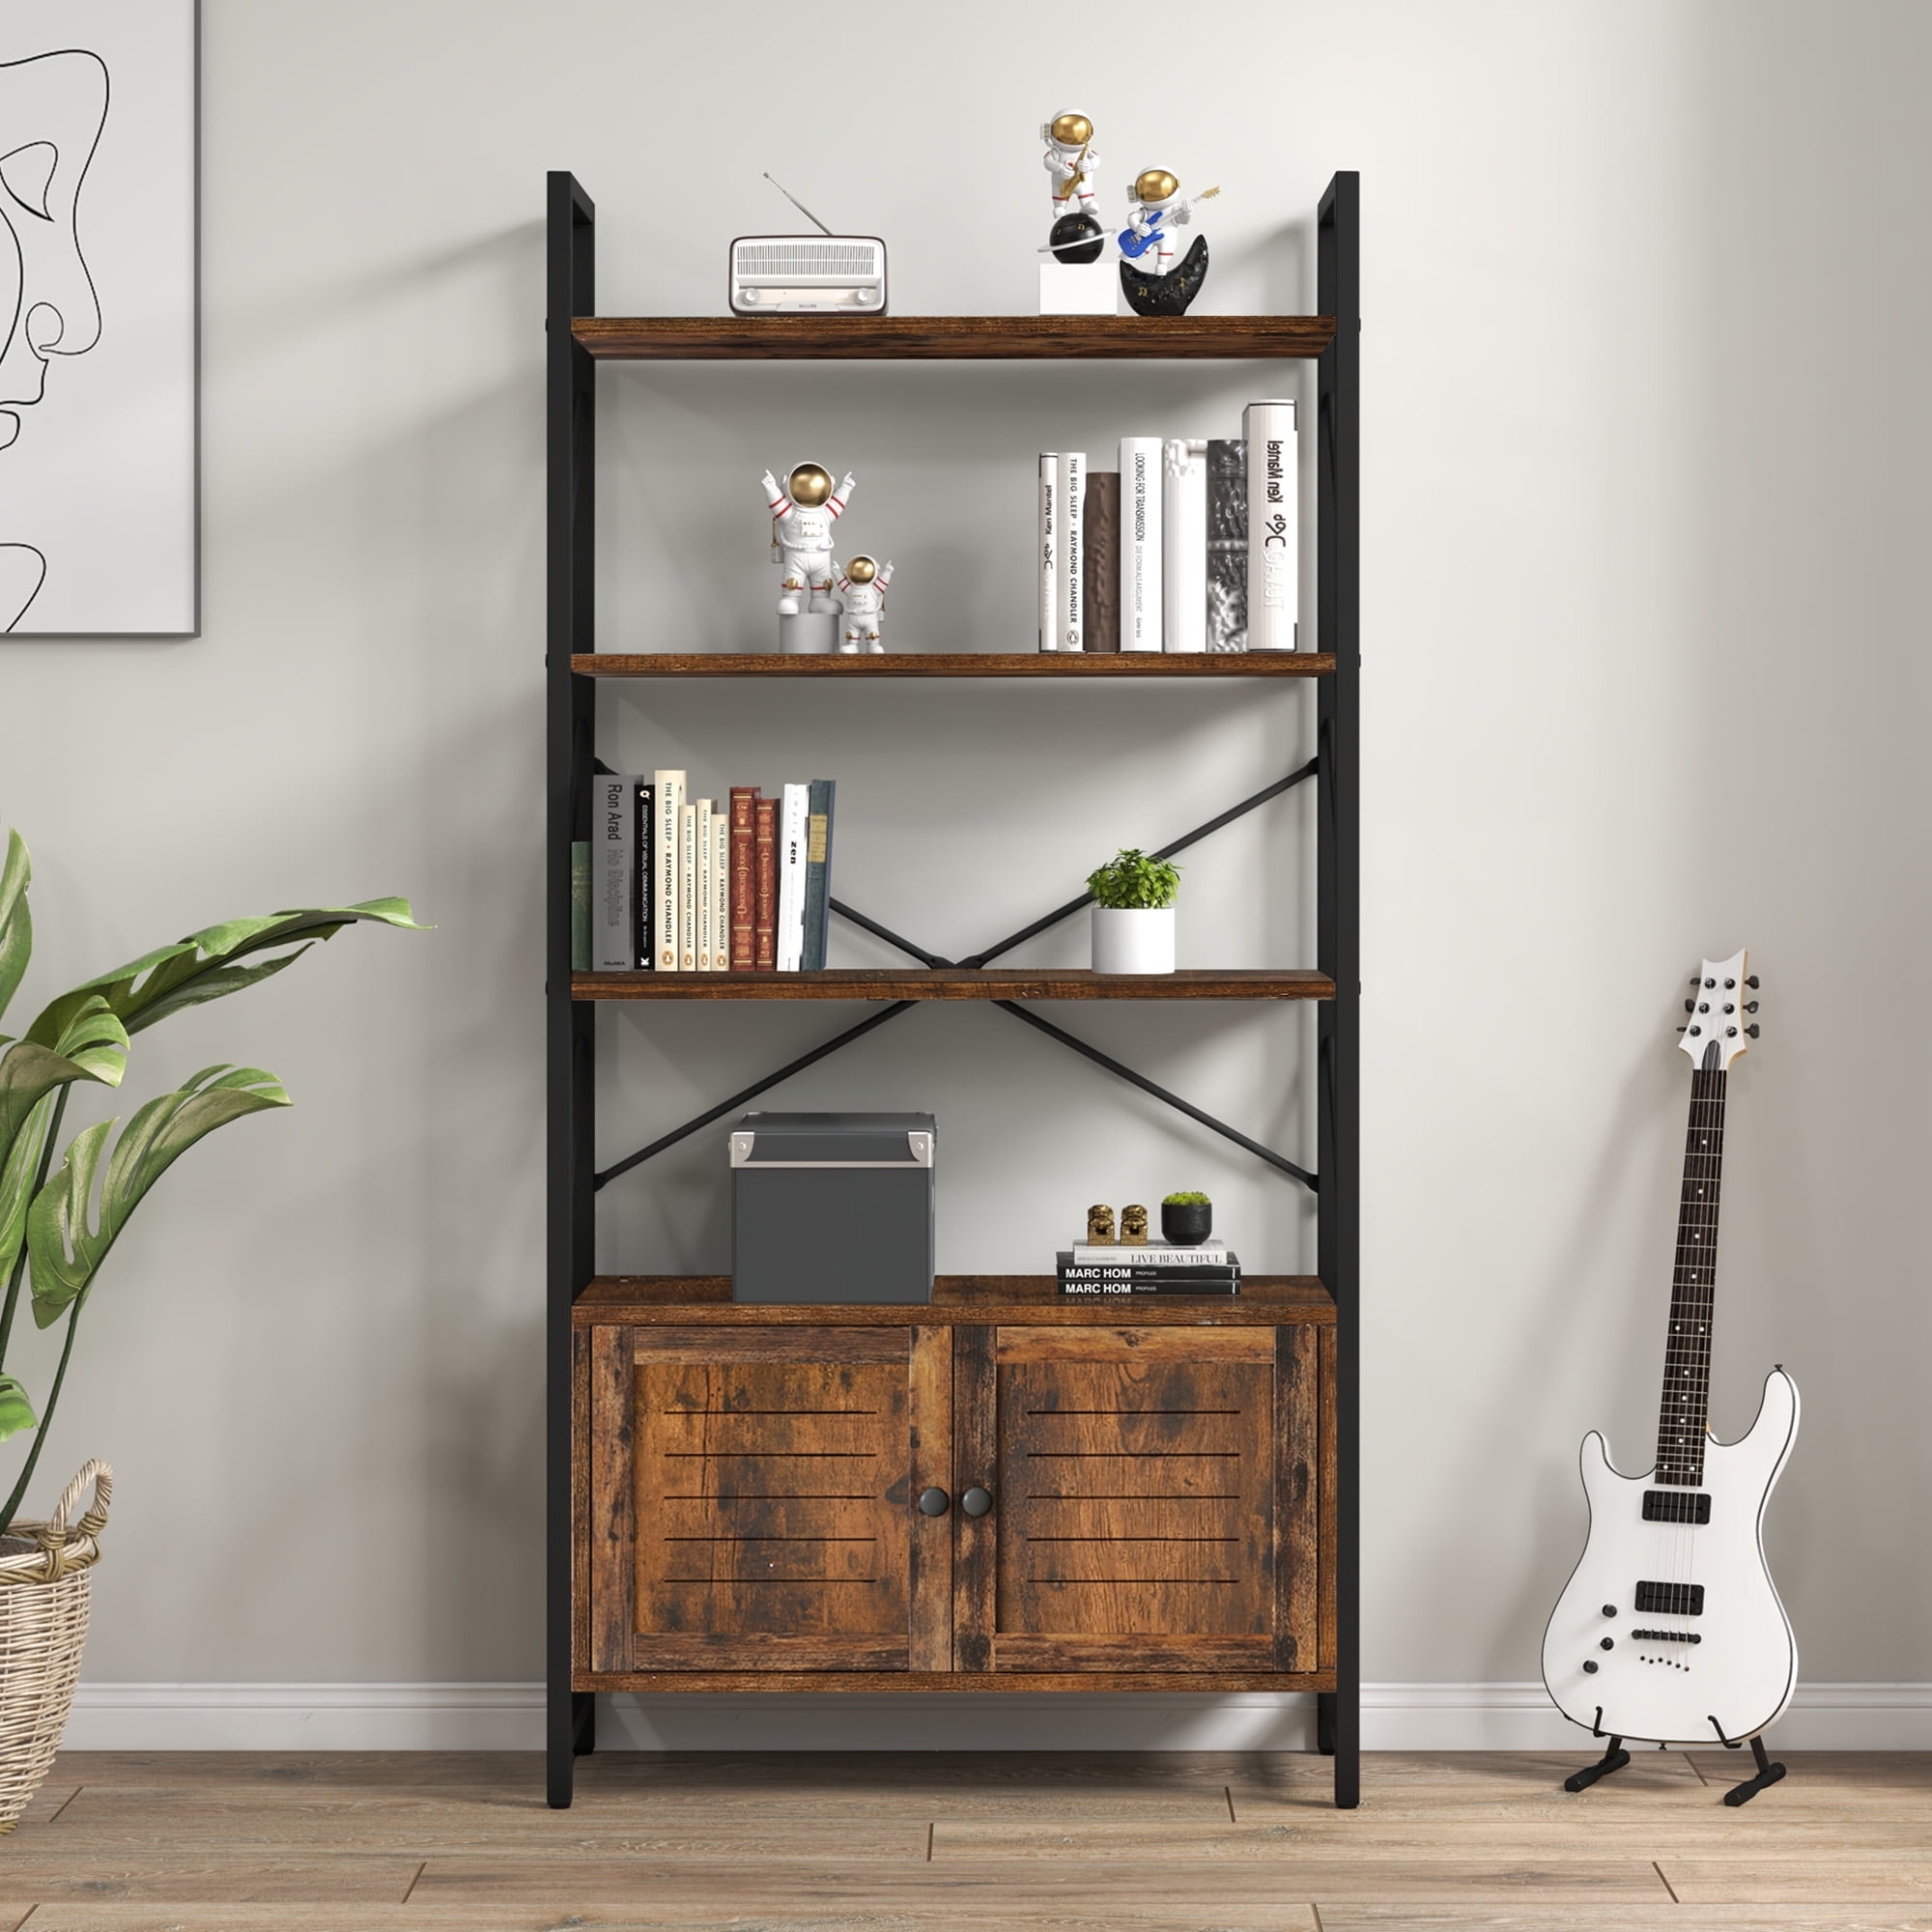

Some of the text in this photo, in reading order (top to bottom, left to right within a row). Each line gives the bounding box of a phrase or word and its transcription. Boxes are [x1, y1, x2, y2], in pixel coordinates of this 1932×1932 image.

[1134, 452, 1145, 541] LOOKING FOR TRANSMISSION
[607, 784, 622, 840] Ron Arad
[641, 840, 648, 849] OF
[604, 849, 623, 927] No Discipline
[1131, 1254, 1221, 1264] LIVE BEAUTIFUL
[1065, 1268, 1101, 1279] MARC
[1103, 1268, 1131, 1279] HOM
[1065, 1283, 1101, 1293] MARC
[1103, 1283, 1131, 1293] HOM
